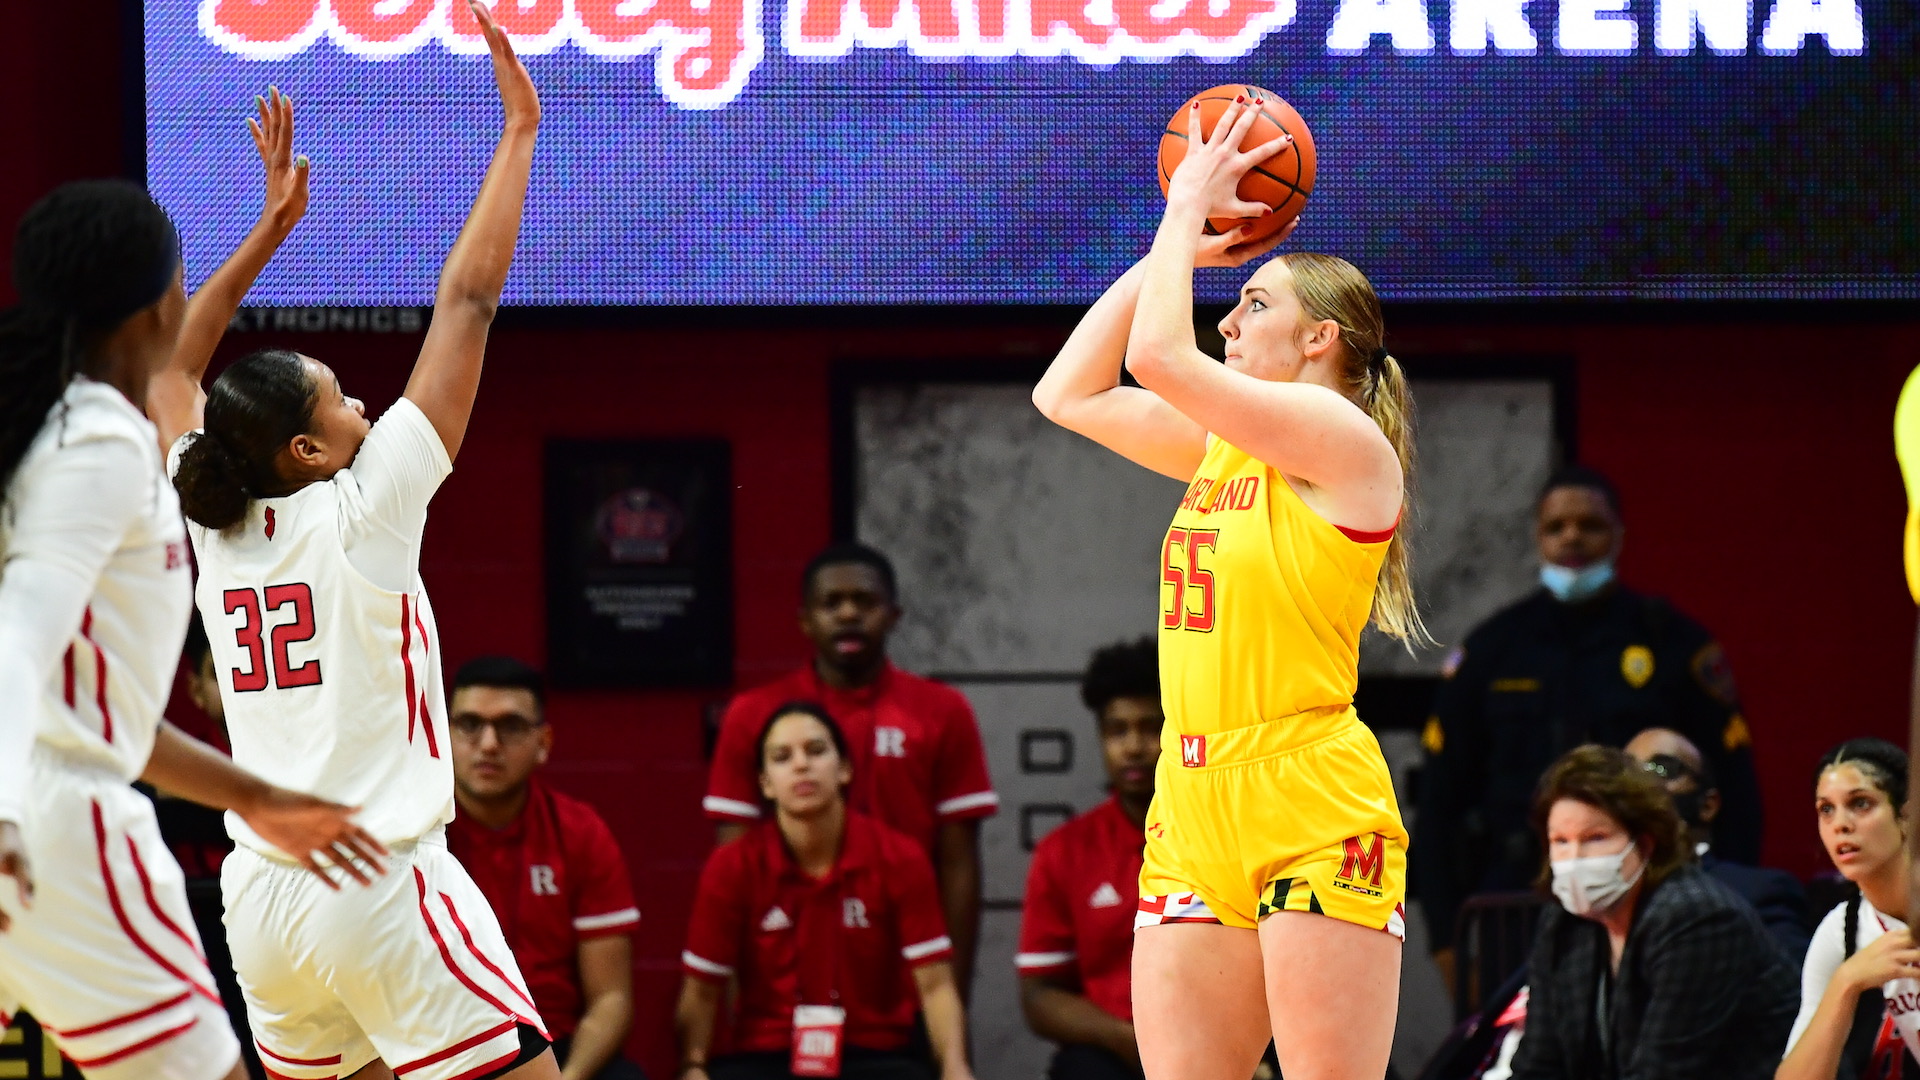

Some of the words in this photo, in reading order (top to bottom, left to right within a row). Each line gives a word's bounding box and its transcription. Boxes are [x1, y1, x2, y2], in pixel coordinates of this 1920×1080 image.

[1162, 526, 1219, 633] 55
[223, 582, 322, 692] 32
[874, 726, 906, 758] R
[1182, 737, 1200, 763] M
[1335, 832, 1387, 889] M
[530, 864, 560, 896] R
[843, 898, 870, 928] R
